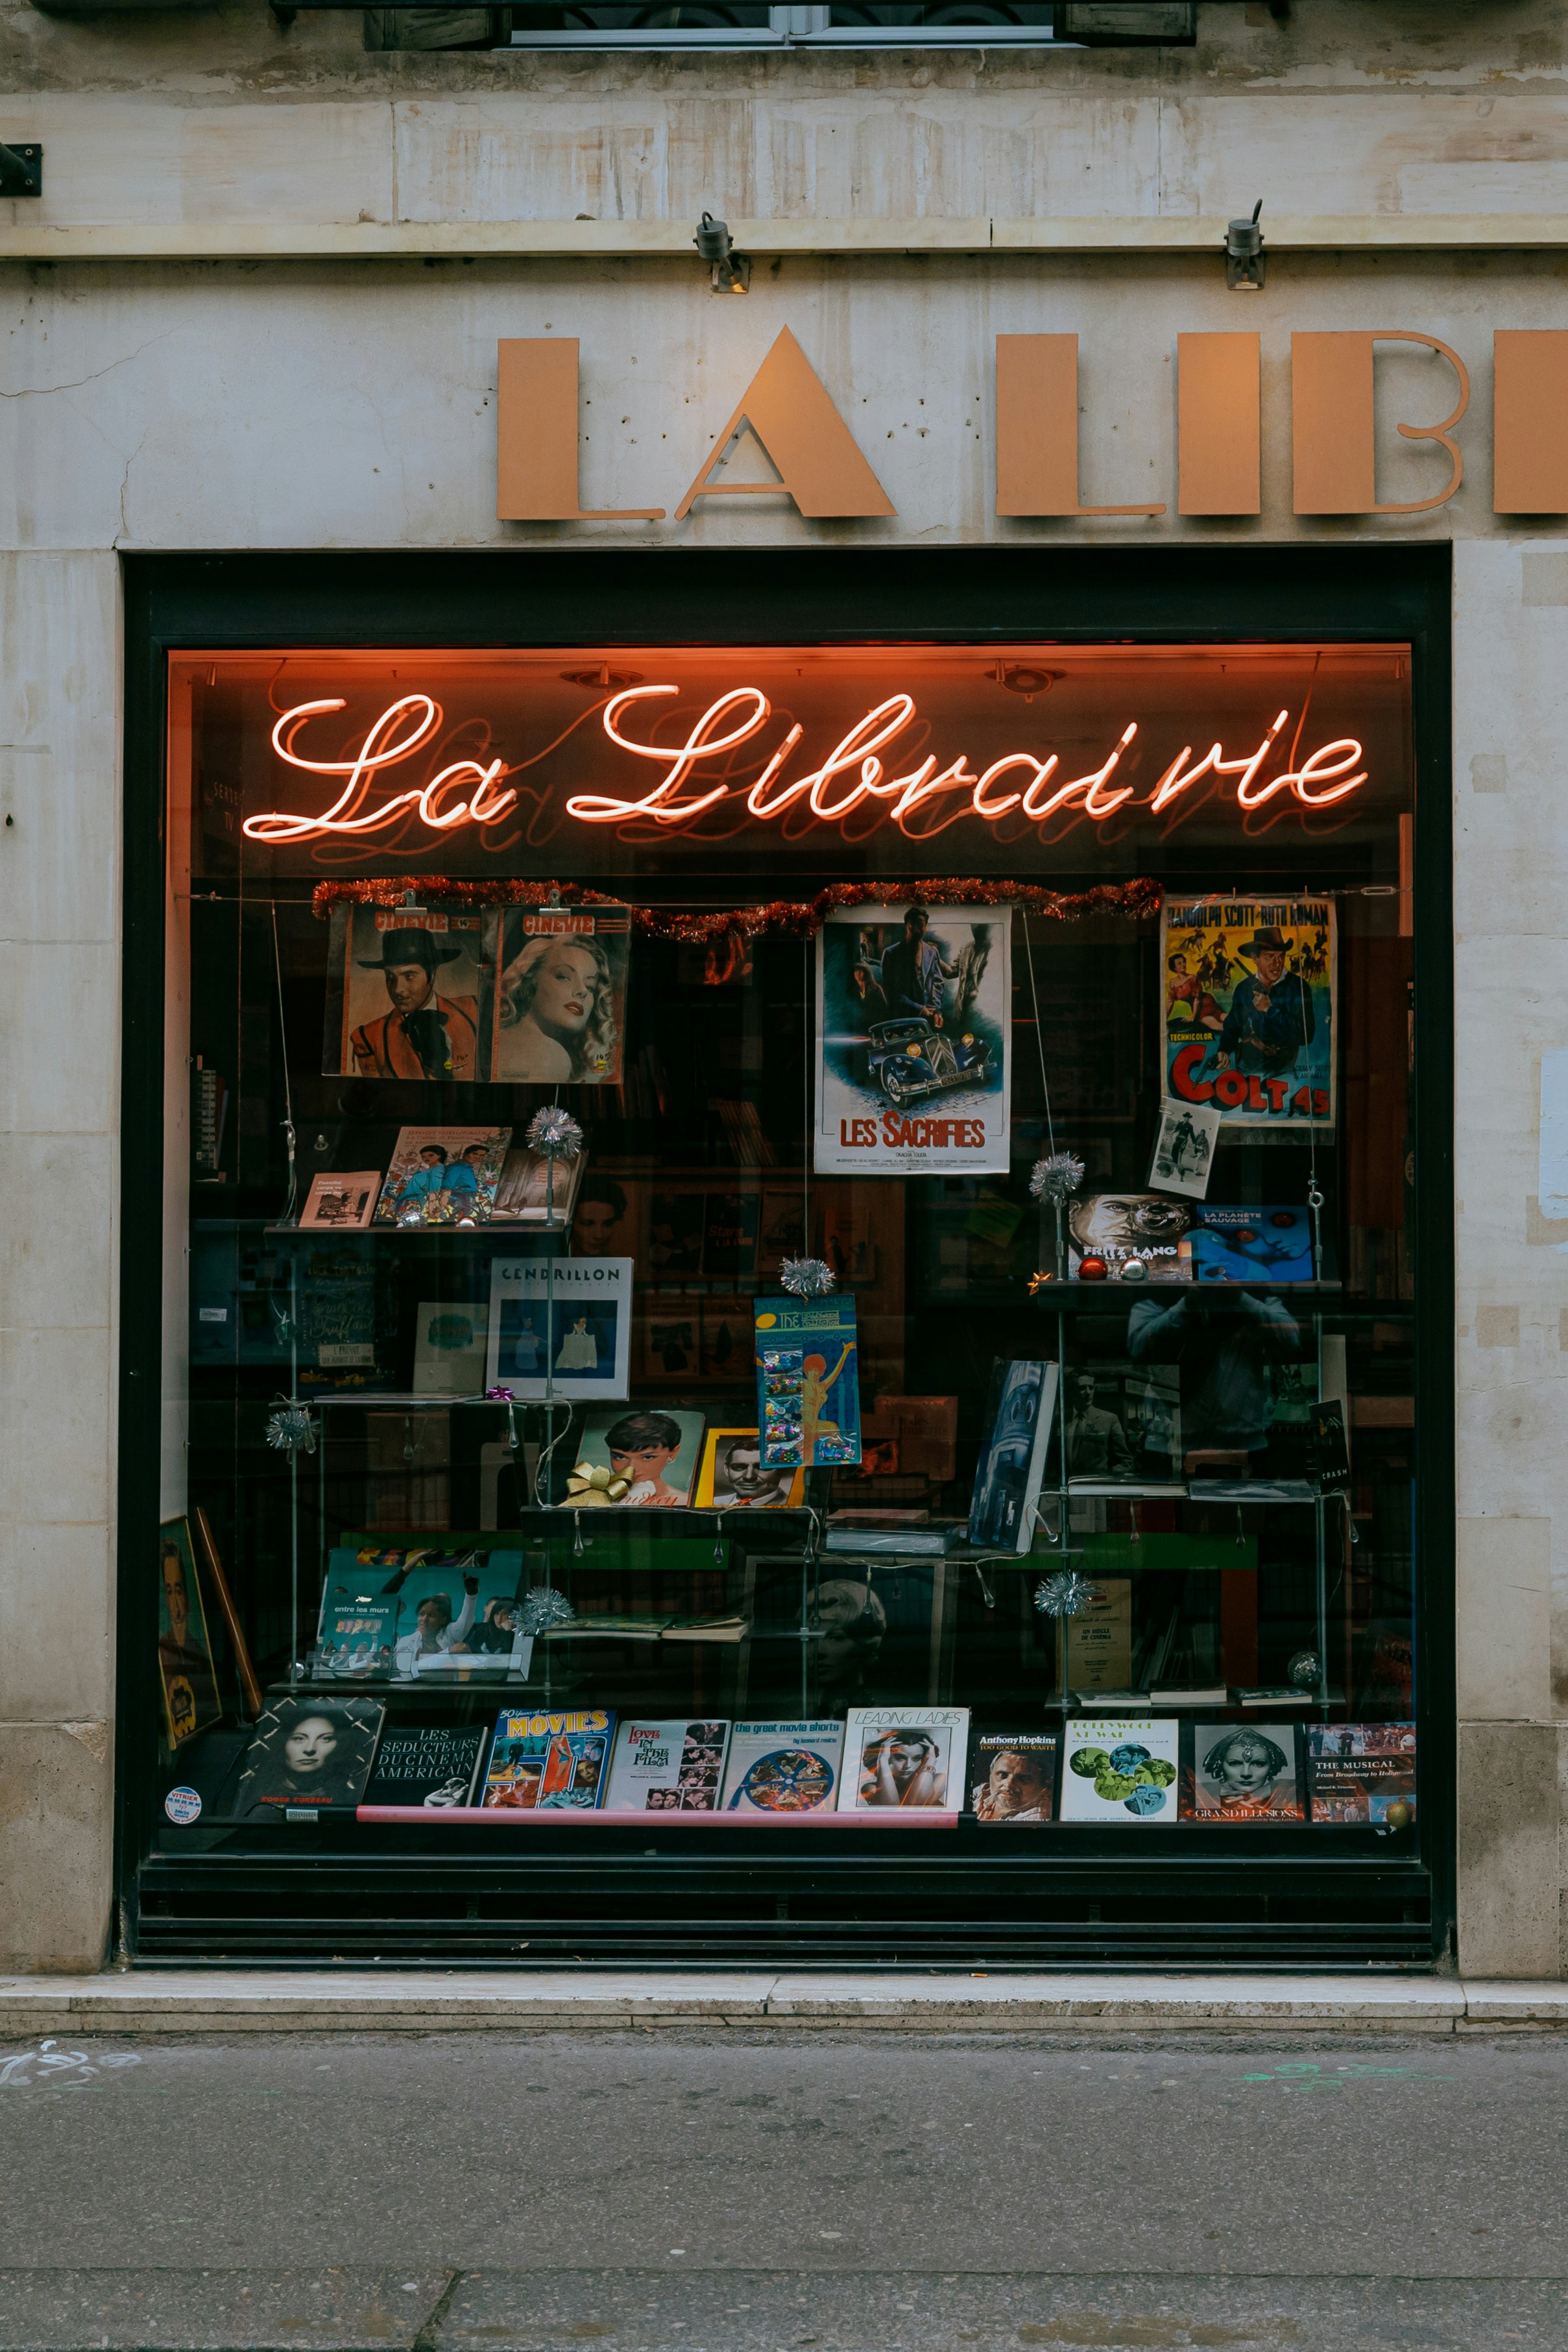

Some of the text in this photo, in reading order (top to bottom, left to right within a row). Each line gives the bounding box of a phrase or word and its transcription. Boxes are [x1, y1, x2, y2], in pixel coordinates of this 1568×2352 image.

[497, 324, 898, 522] LA
[241, 683, 1369, 842] La Librairie
[374, 910, 448, 932] CINEVIE
[1168, 904, 1329, 927] RANDOLPH SCOTT RUTH ROMAN
[522, 915, 595, 936] CINEVIE
[1170, 1032, 1213, 1041] TECHNICOLOR
[1170, 1043, 1288, 1114] COLT
[840, 1118, 876, 1148] LES
[1083, 1245, 1177, 1255] FRITZ LANG
[501, 1267, 620, 1281] CENDRILLON
[1322, 1468, 1347, 1479] CRASH
[618, 1492, 679, 1507] udrey
[499, 1709, 515, 1719] 50
[515, 1710, 533, 1719] Years
[854, 1711, 963, 1725] LEADING LADIES
[507, 1710, 609, 1738] MOVIES
[735, 1722, 839, 1734] the great movie shorts
[420, 1729, 450, 1740] LES
[627, 1726, 660, 1744] LOVE
[980, 1736, 1019, 1745] Anthony
[381, 1736, 479, 1752] SEDUCTEURS
[638, 1740, 654, 1748] IN
[379, 1750, 474, 1765] DU CINEMA
[633, 1752, 669, 1767] FILM
[643, 1748, 669, 1759] THE
[375, 1762, 474, 1778] AMERICAIN
[1343, 1761, 1395, 1769] MUSICAL
[172, 1792, 198, 1801] VITRIER
[1195, 1809, 1297, 1817] GRAND ILLUSIONS
